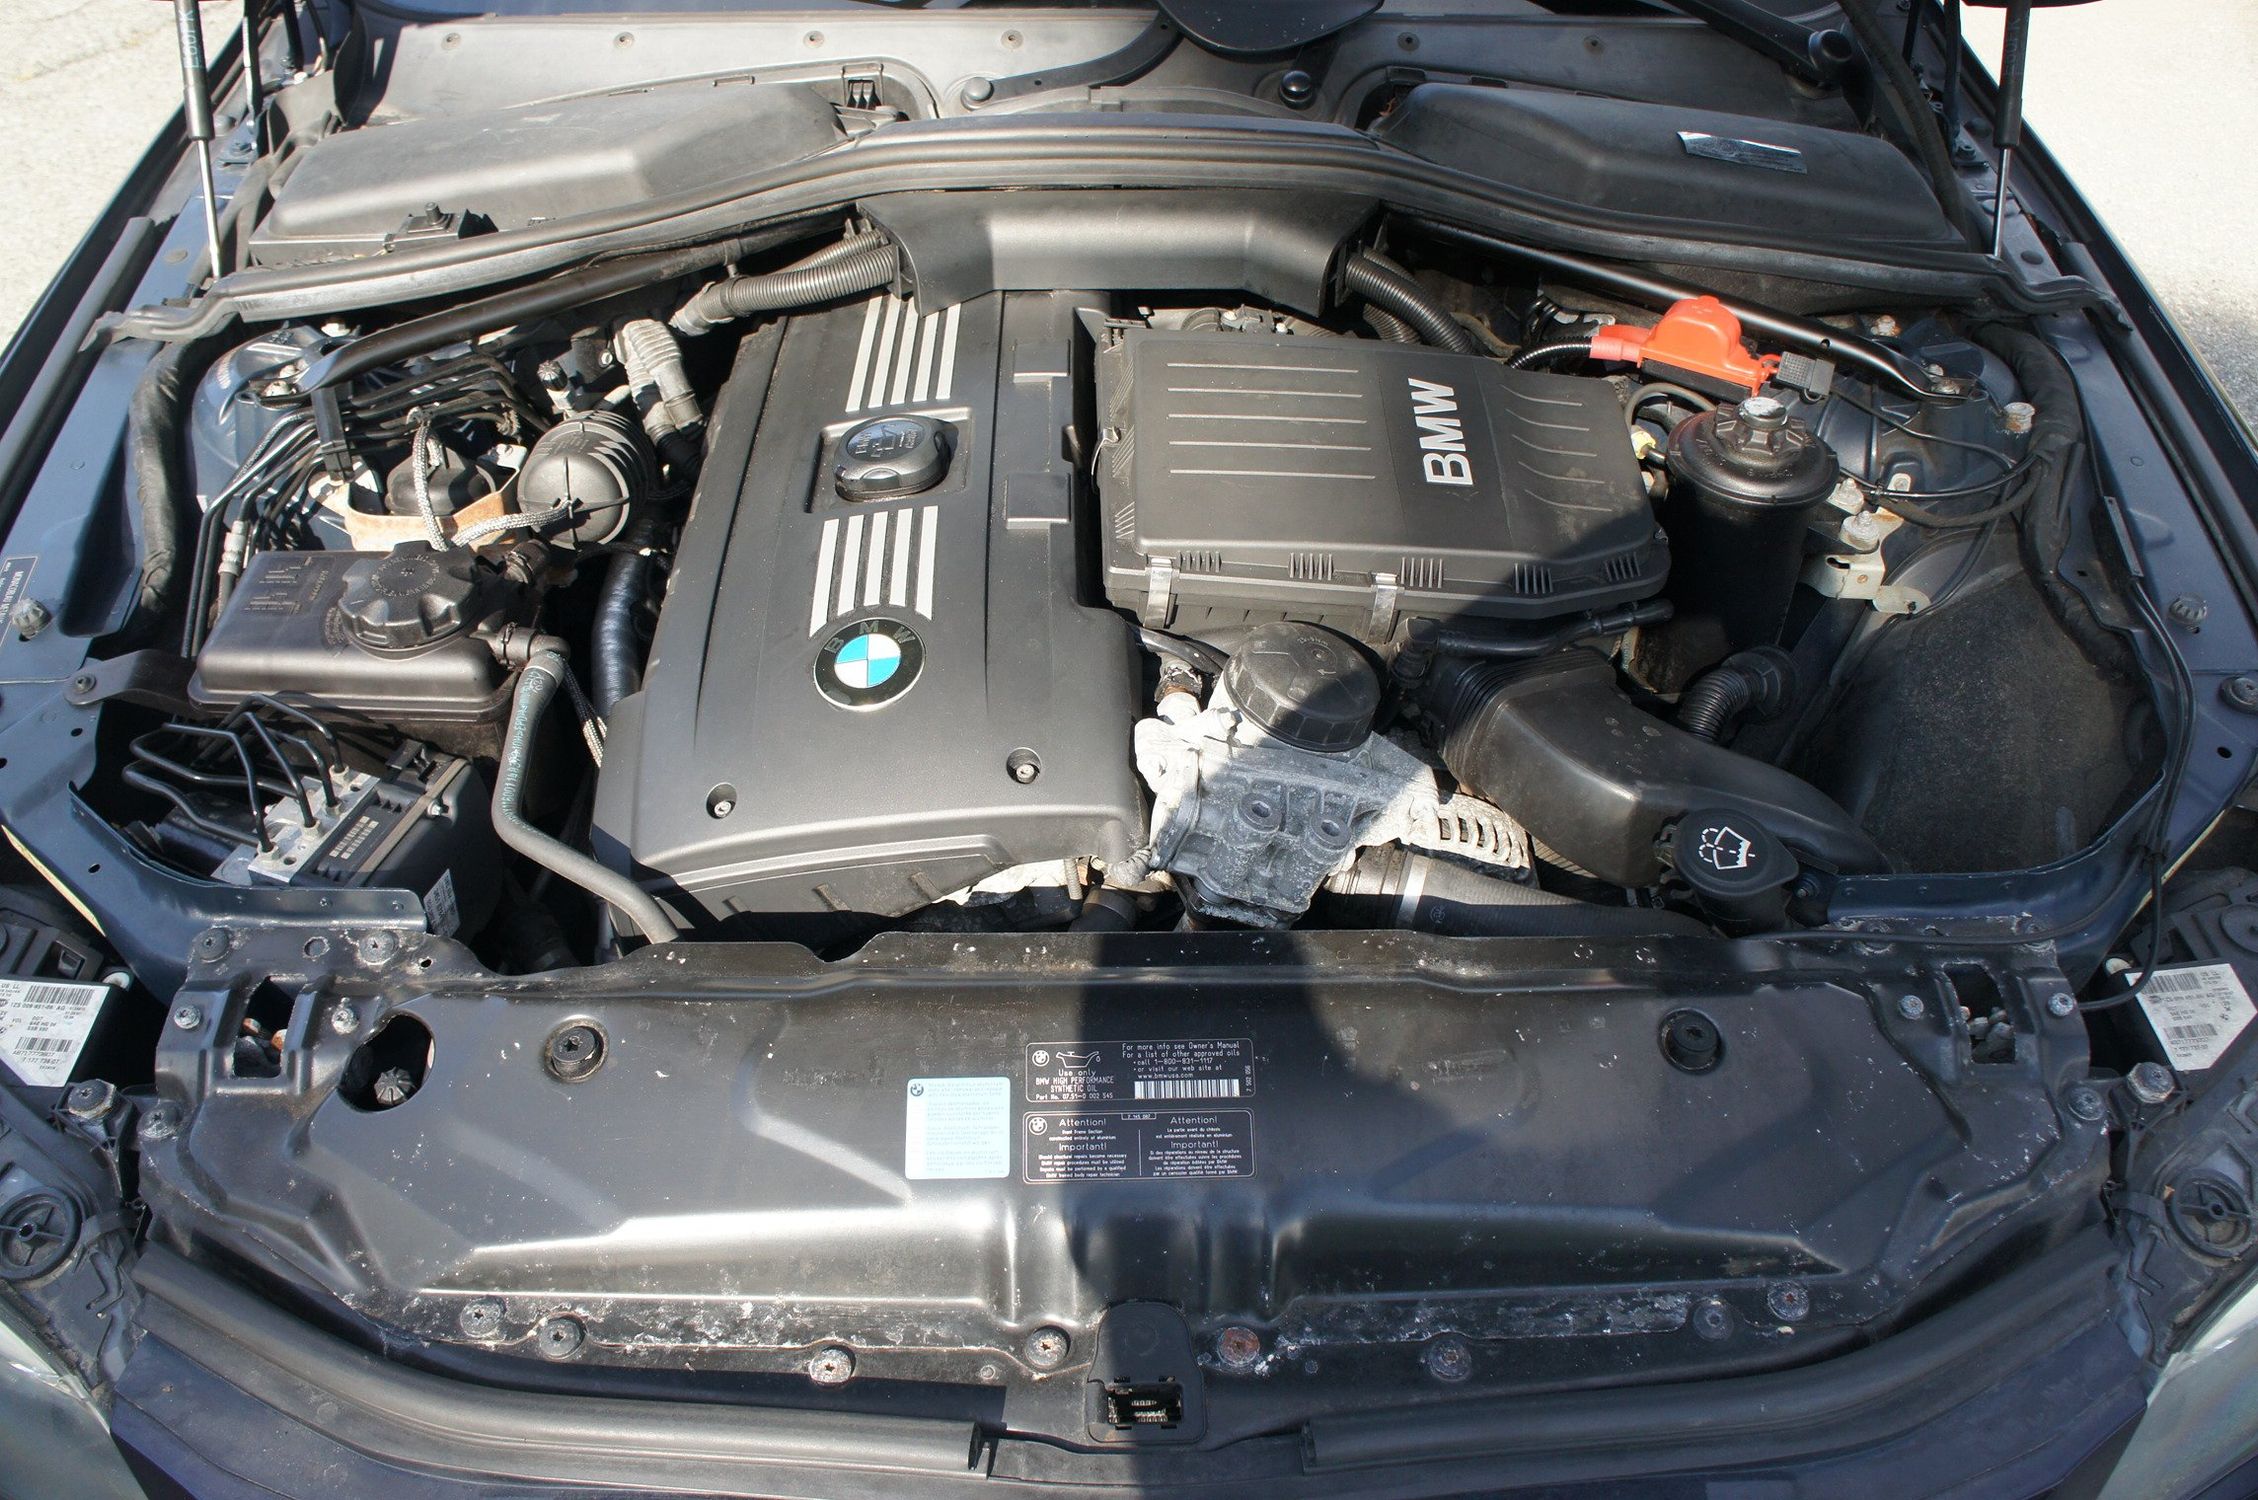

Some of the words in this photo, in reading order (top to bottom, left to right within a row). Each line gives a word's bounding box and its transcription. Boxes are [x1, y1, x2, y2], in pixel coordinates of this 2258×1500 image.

[1408, 378, 1473, 485] BMW
[824, 620, 916, 654] BMW
[1157, 1042, 1170, 1050] info
[1189, 1041, 1213, 1049] Owner's
[1217, 1041, 1240, 1049] Manual
[1194, 1049, 1223, 1058] approved
[1078, 1069, 1096, 1078] only
[1053, 1077, 1067, 1085] HIGH
[1071, 1076, 1114, 1084] PERFORMANCE
[1051, 1085, 1084, 1093] SYNTHETIC
[1059, 1118, 1106, 1127] Attention!
[1170, 1116, 1218, 1124] Attention!
[1059, 1142, 1106, 1152] Important!
[1171, 1140, 1218, 1149] Important!
